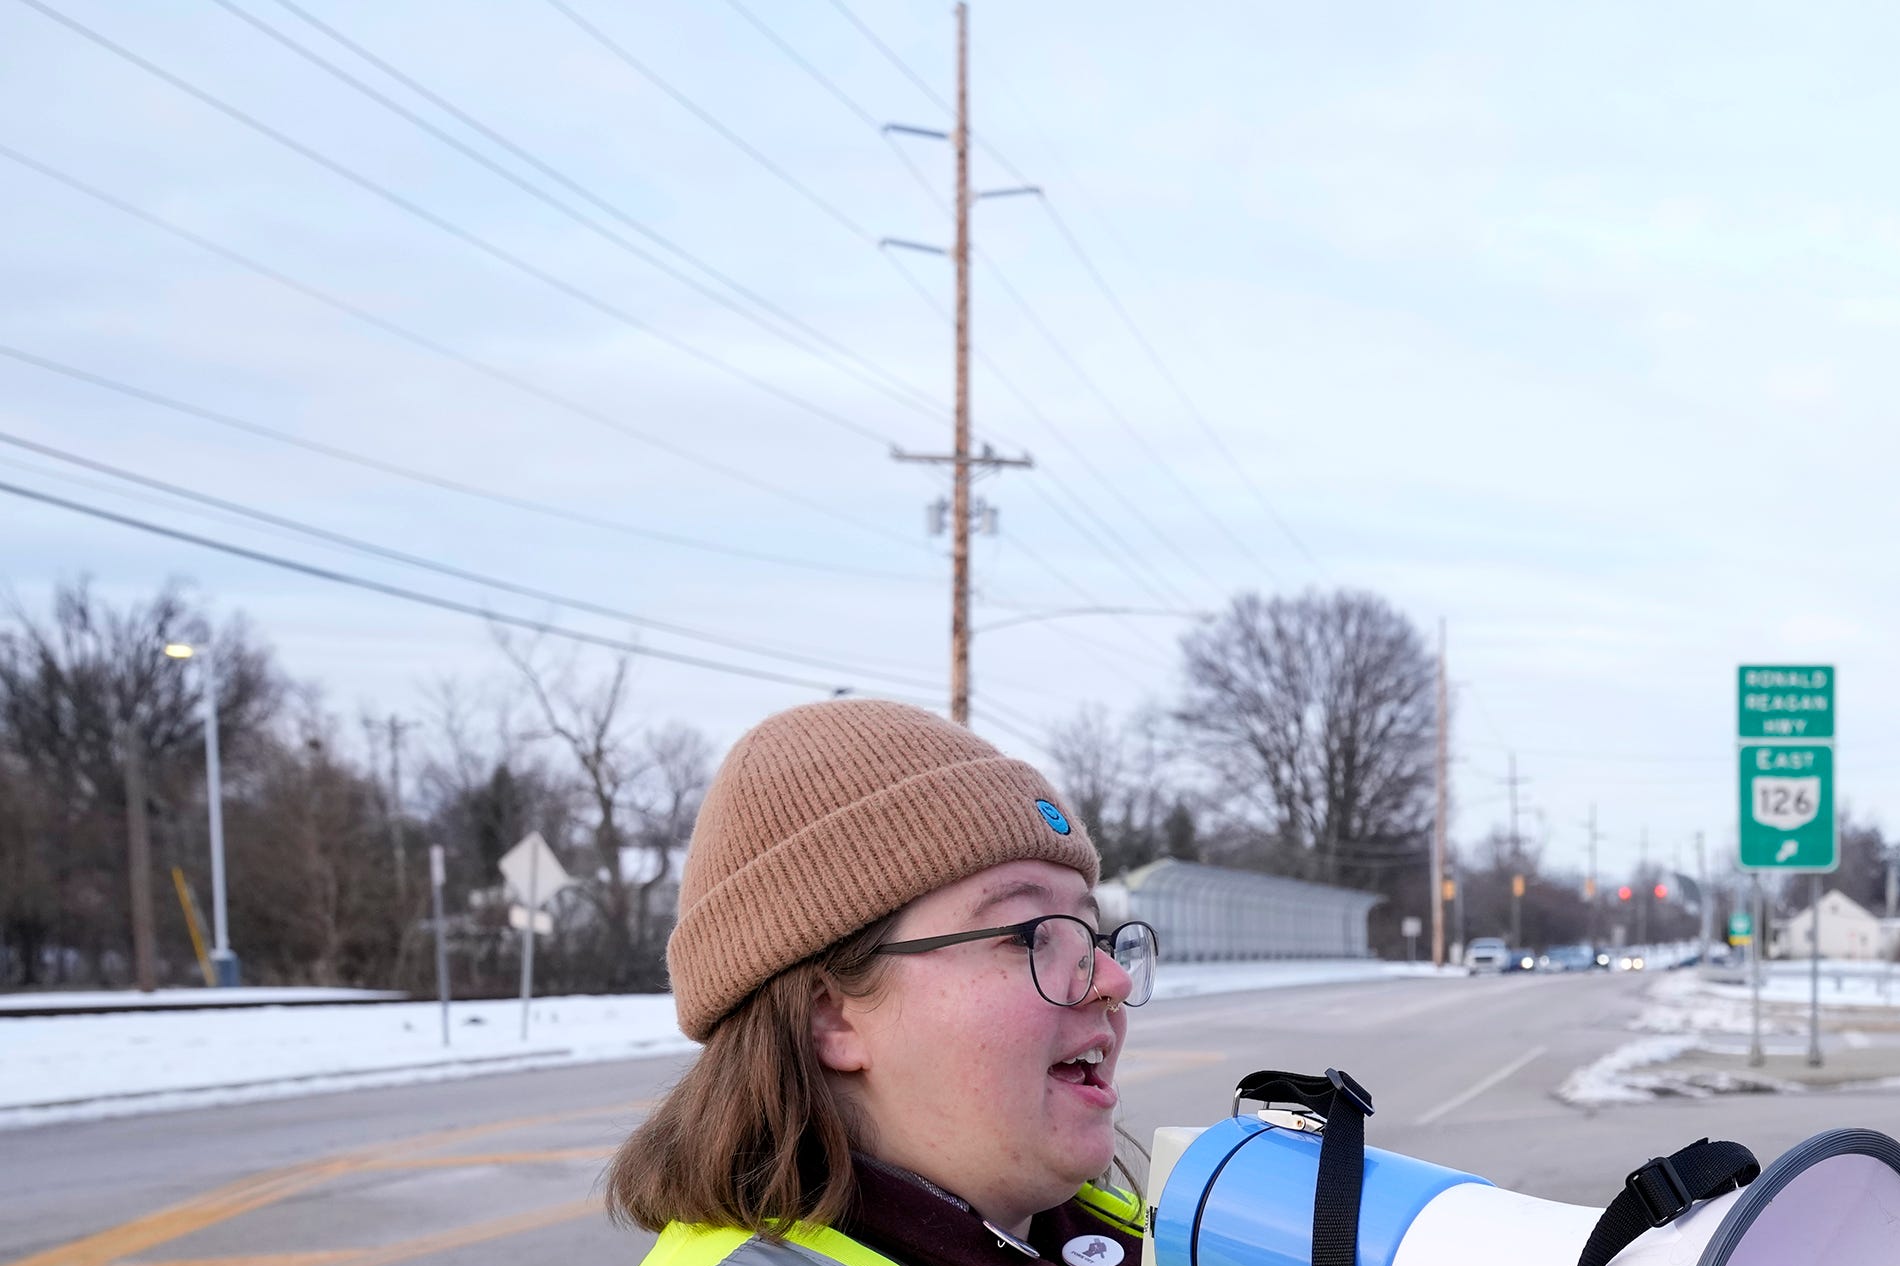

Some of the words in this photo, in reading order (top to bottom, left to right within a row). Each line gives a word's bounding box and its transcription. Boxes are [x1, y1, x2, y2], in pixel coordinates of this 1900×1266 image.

[1745, 670, 1827, 688] RONALD
[1745, 693, 1828, 712] REAGAN
[1756, 747, 1814, 770] EAST
[1759, 787, 1812, 816] 126
